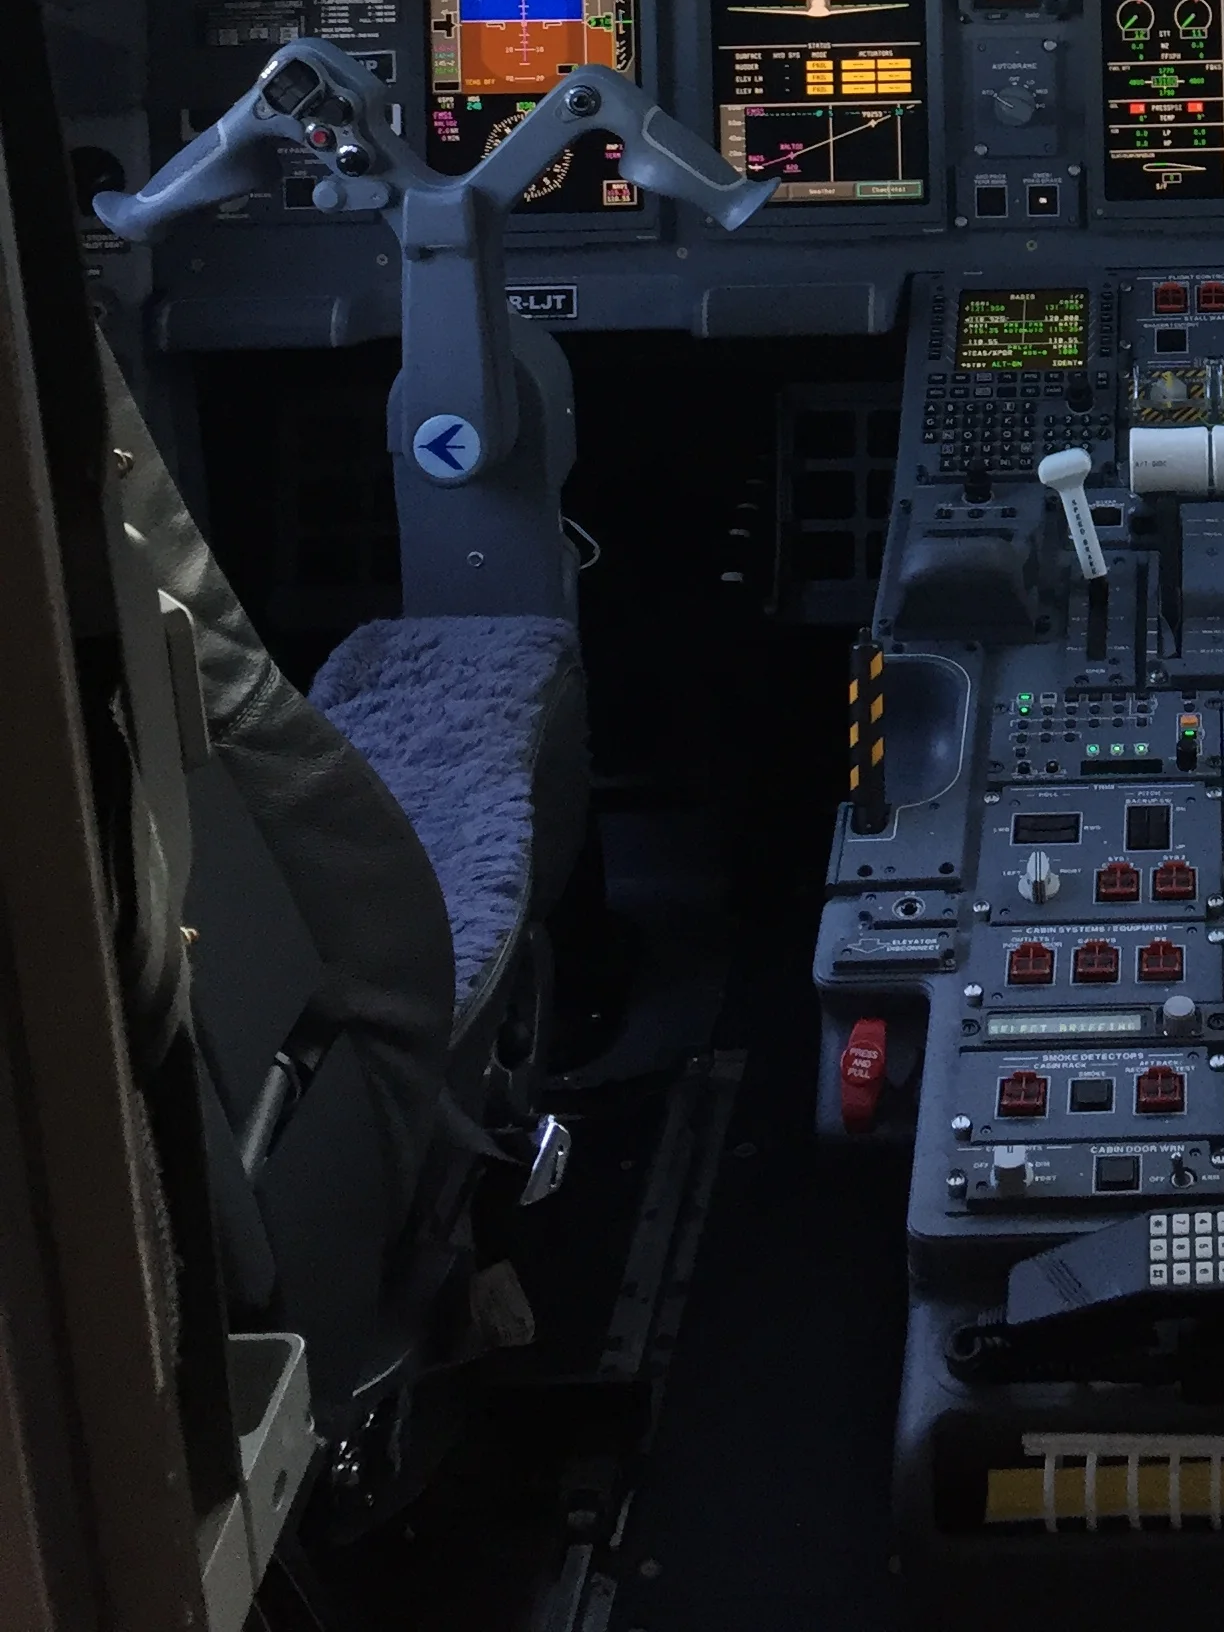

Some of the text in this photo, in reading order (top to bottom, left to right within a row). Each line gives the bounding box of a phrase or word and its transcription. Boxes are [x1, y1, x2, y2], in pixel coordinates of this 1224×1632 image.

[508, 294, 568, 311] R-LJT
[1025, 924, 1169, 935] CABIN SYSTEMS EQUIPMENT
[891, 937, 938, 946] ELEVATOR
[848, 1047, 879, 1059] PRESS
[1041, 1052, 1145, 1062] SMOKE DETECTORS
[851, 1058, 873, 1069] AND
[846, 1067, 872, 1080] PULL
[1090, 1144, 1186, 1154] CABIN DOOR WRN
[1148, 1175, 1165, 1183] OFF
